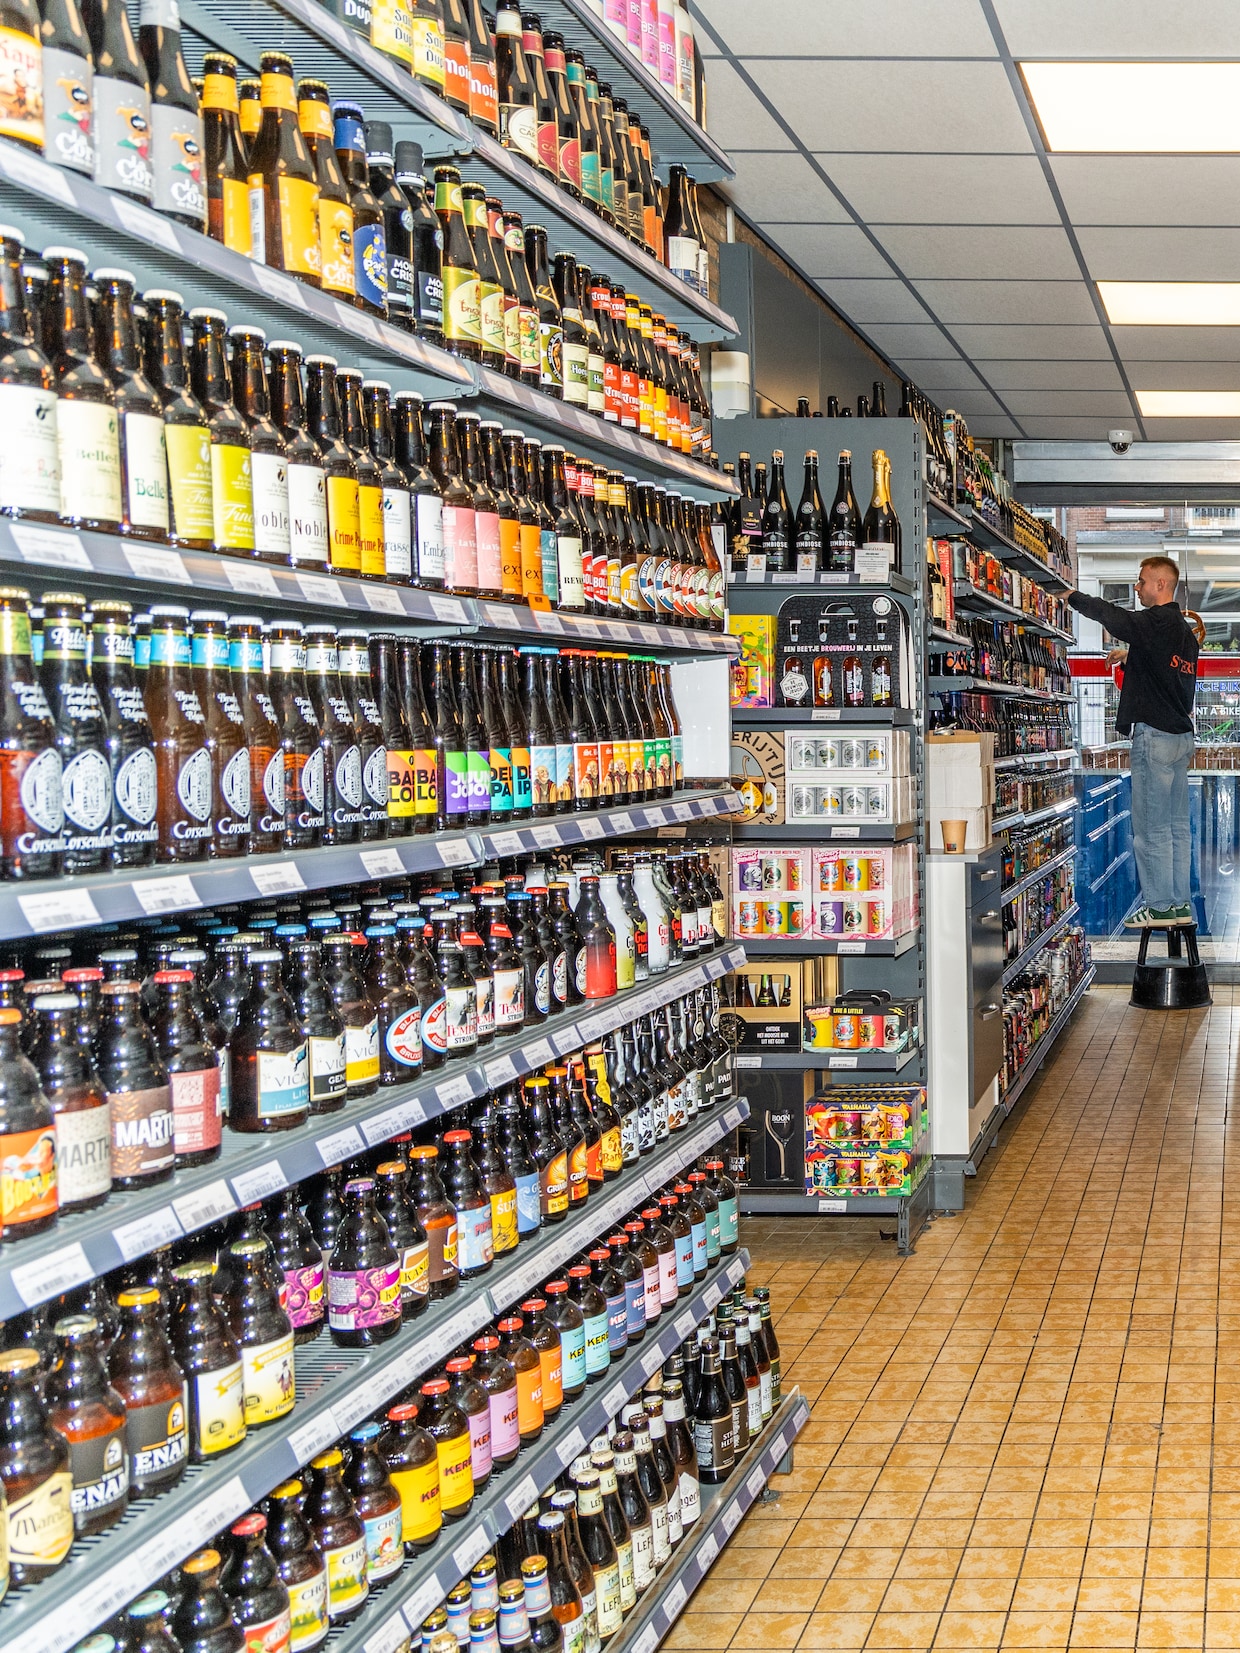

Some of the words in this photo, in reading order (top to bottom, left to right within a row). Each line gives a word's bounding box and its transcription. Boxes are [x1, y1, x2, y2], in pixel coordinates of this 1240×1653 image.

[784, 645, 796, 653] EEN
[797, 645, 819, 653] BEETJE
[1220, 706, 1240, 715] BIKE
[772, 1114, 790, 1122] BOON
